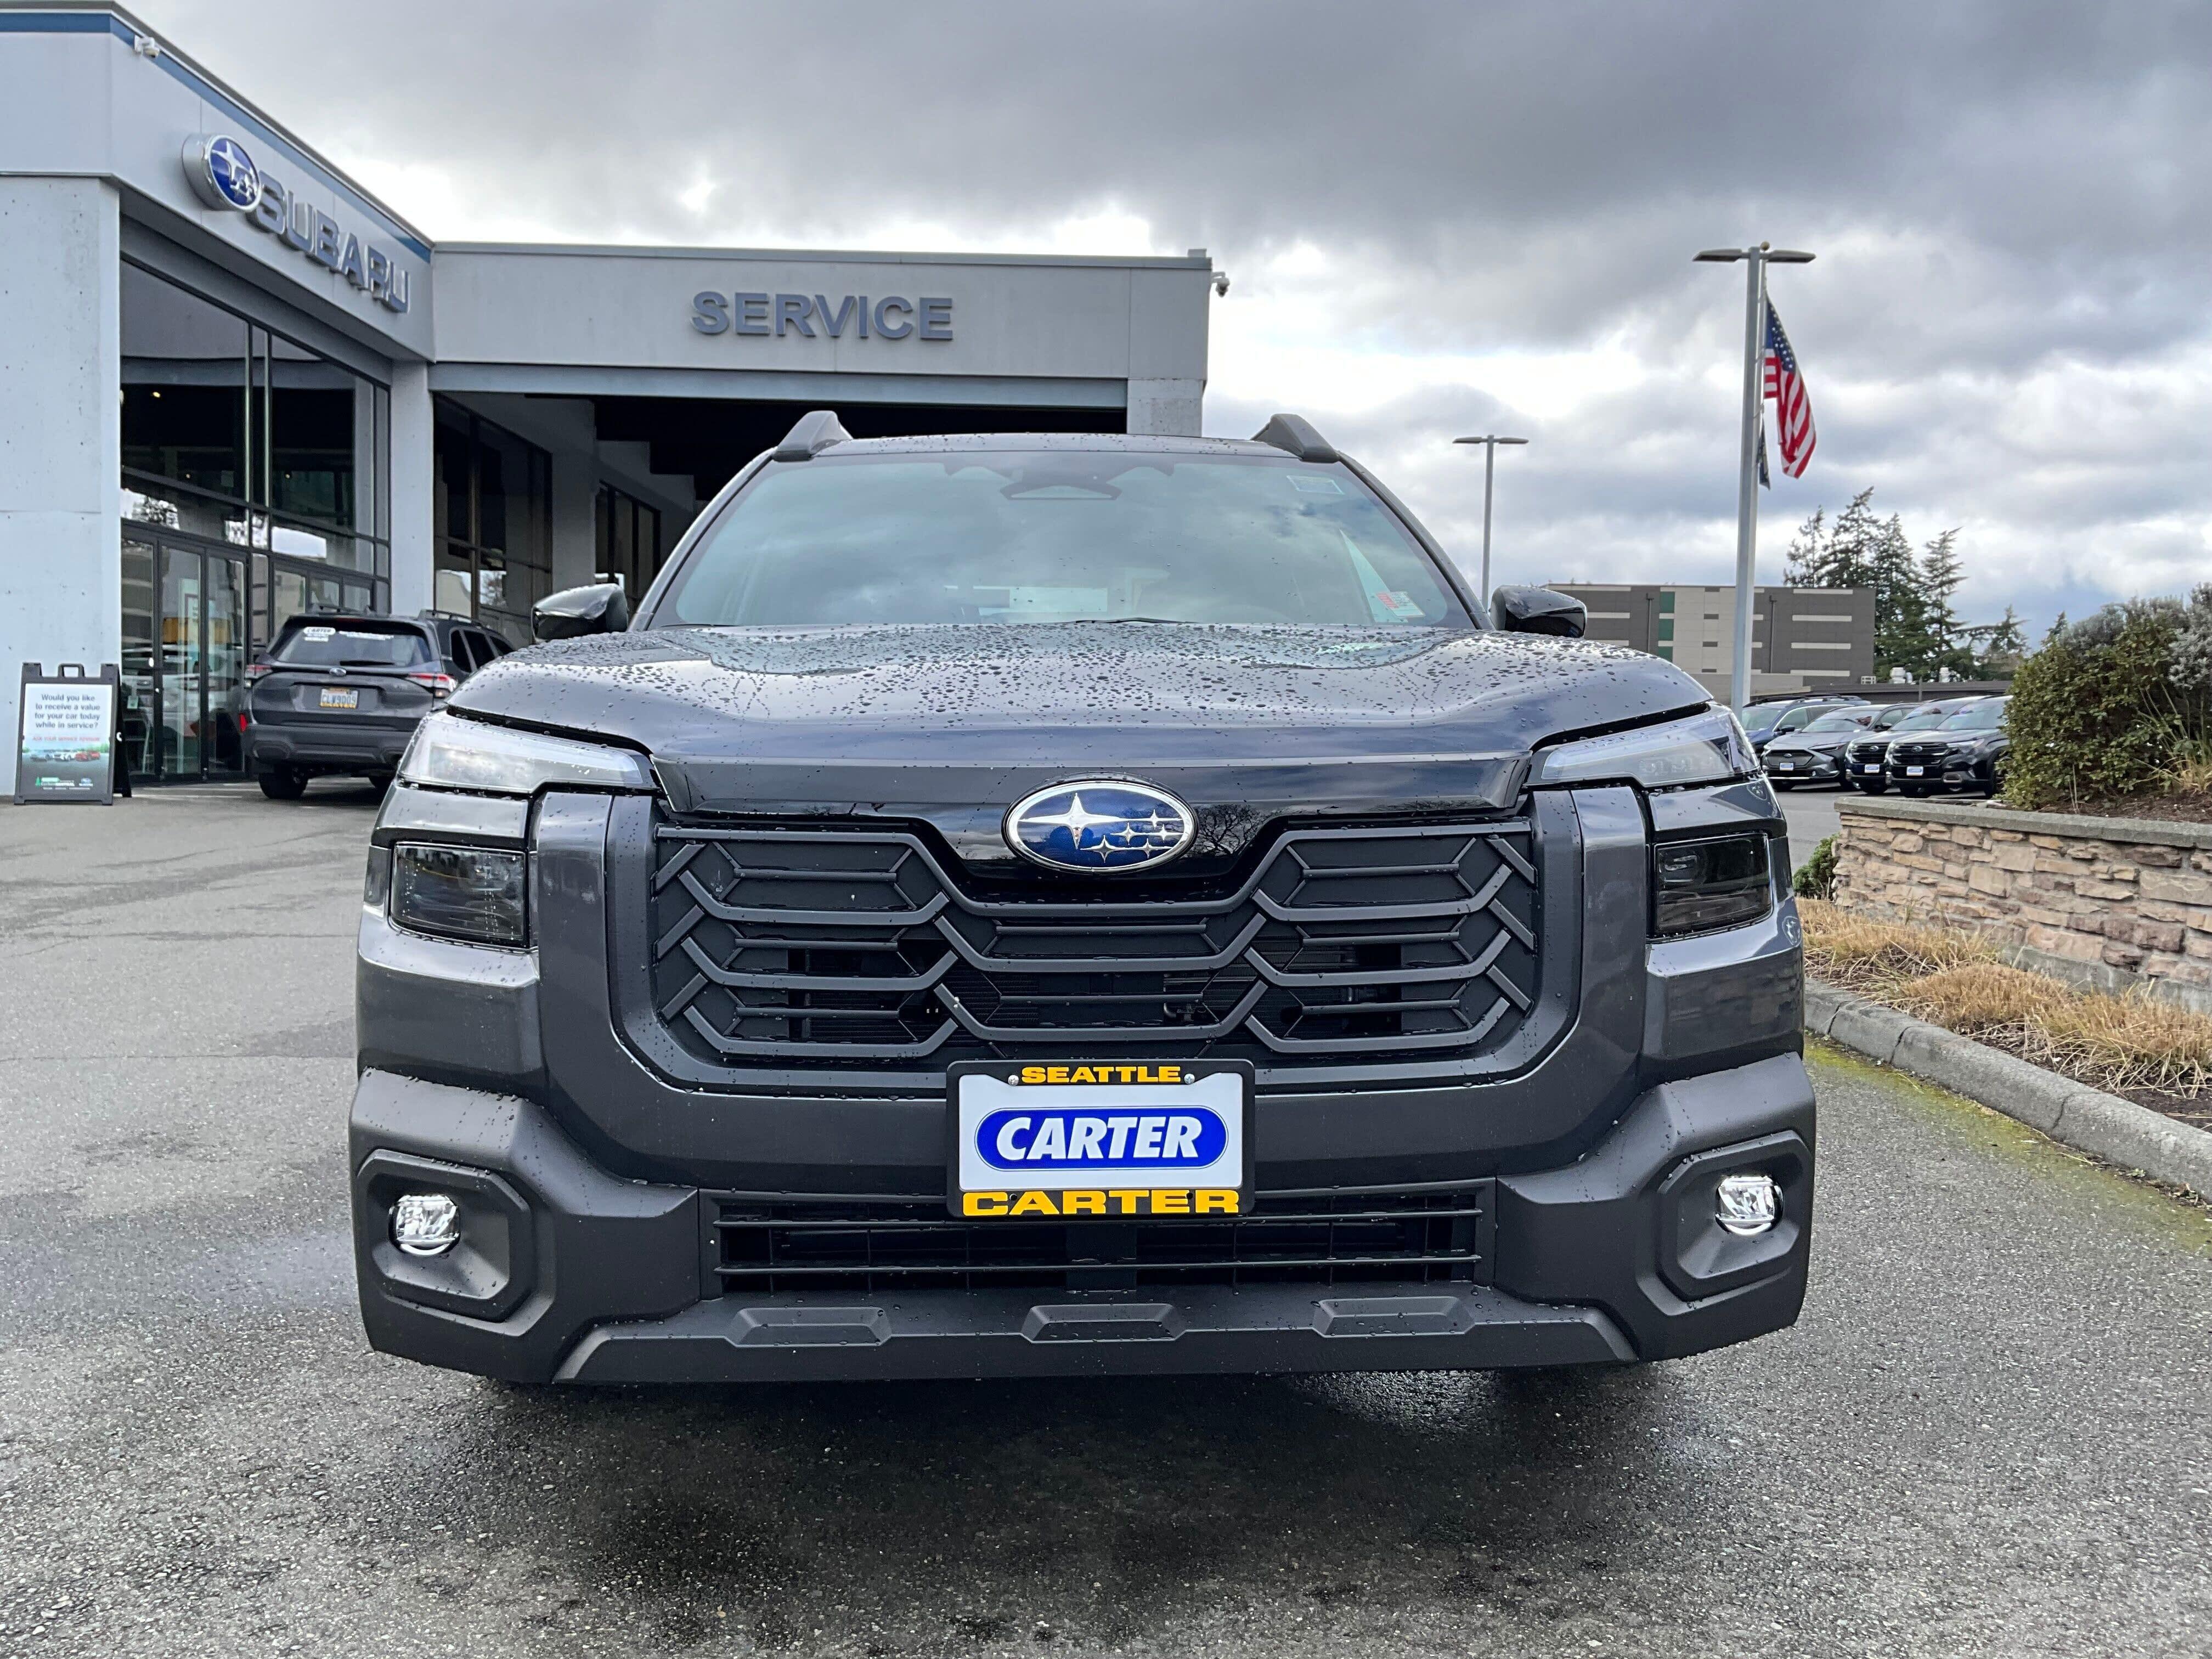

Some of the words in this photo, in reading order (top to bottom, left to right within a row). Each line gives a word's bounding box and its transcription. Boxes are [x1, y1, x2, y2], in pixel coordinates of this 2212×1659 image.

[256, 170, 410, 314] SUBARU
[690, 291, 953, 341] SERVICE
[1022, 1066, 1181, 1084] SEATTLE
[996, 1115, 1203, 1161] CARTER
[962, 1189, 1240, 1216] CARTER
